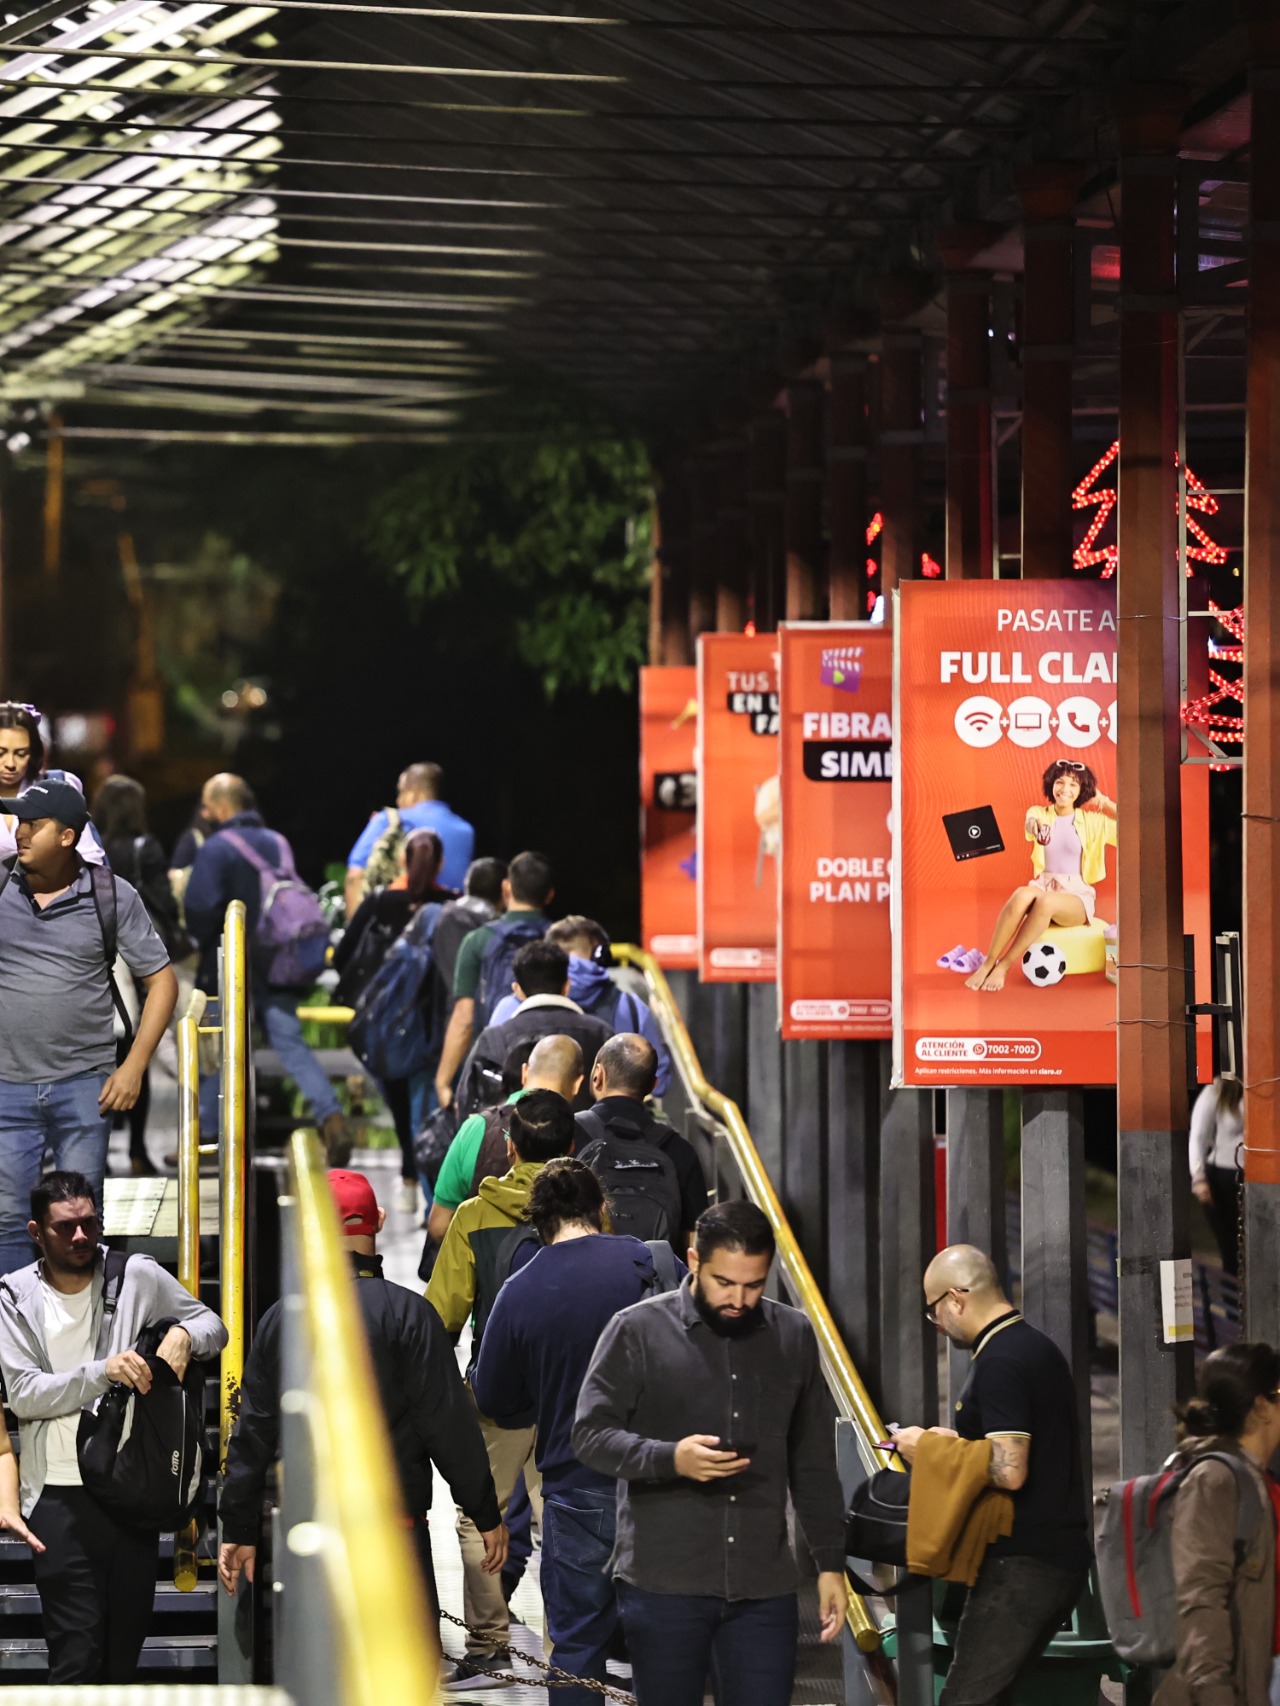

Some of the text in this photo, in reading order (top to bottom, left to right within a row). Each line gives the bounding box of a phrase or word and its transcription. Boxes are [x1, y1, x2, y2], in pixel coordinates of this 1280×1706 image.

[997, 608, 1093, 632] PASATE
[940, 651, 1117, 684] FULL CLA
[726, 670, 770, 692] TUS
[803, 712, 892, 739] FIBRA
[817, 857, 885, 878] DOBLE
[809, 881, 870, 902] PLAN
[921, 1040, 965, 1049] ATENCIÓN
[921, 1049, 968, 1057] AL CLIENTE
